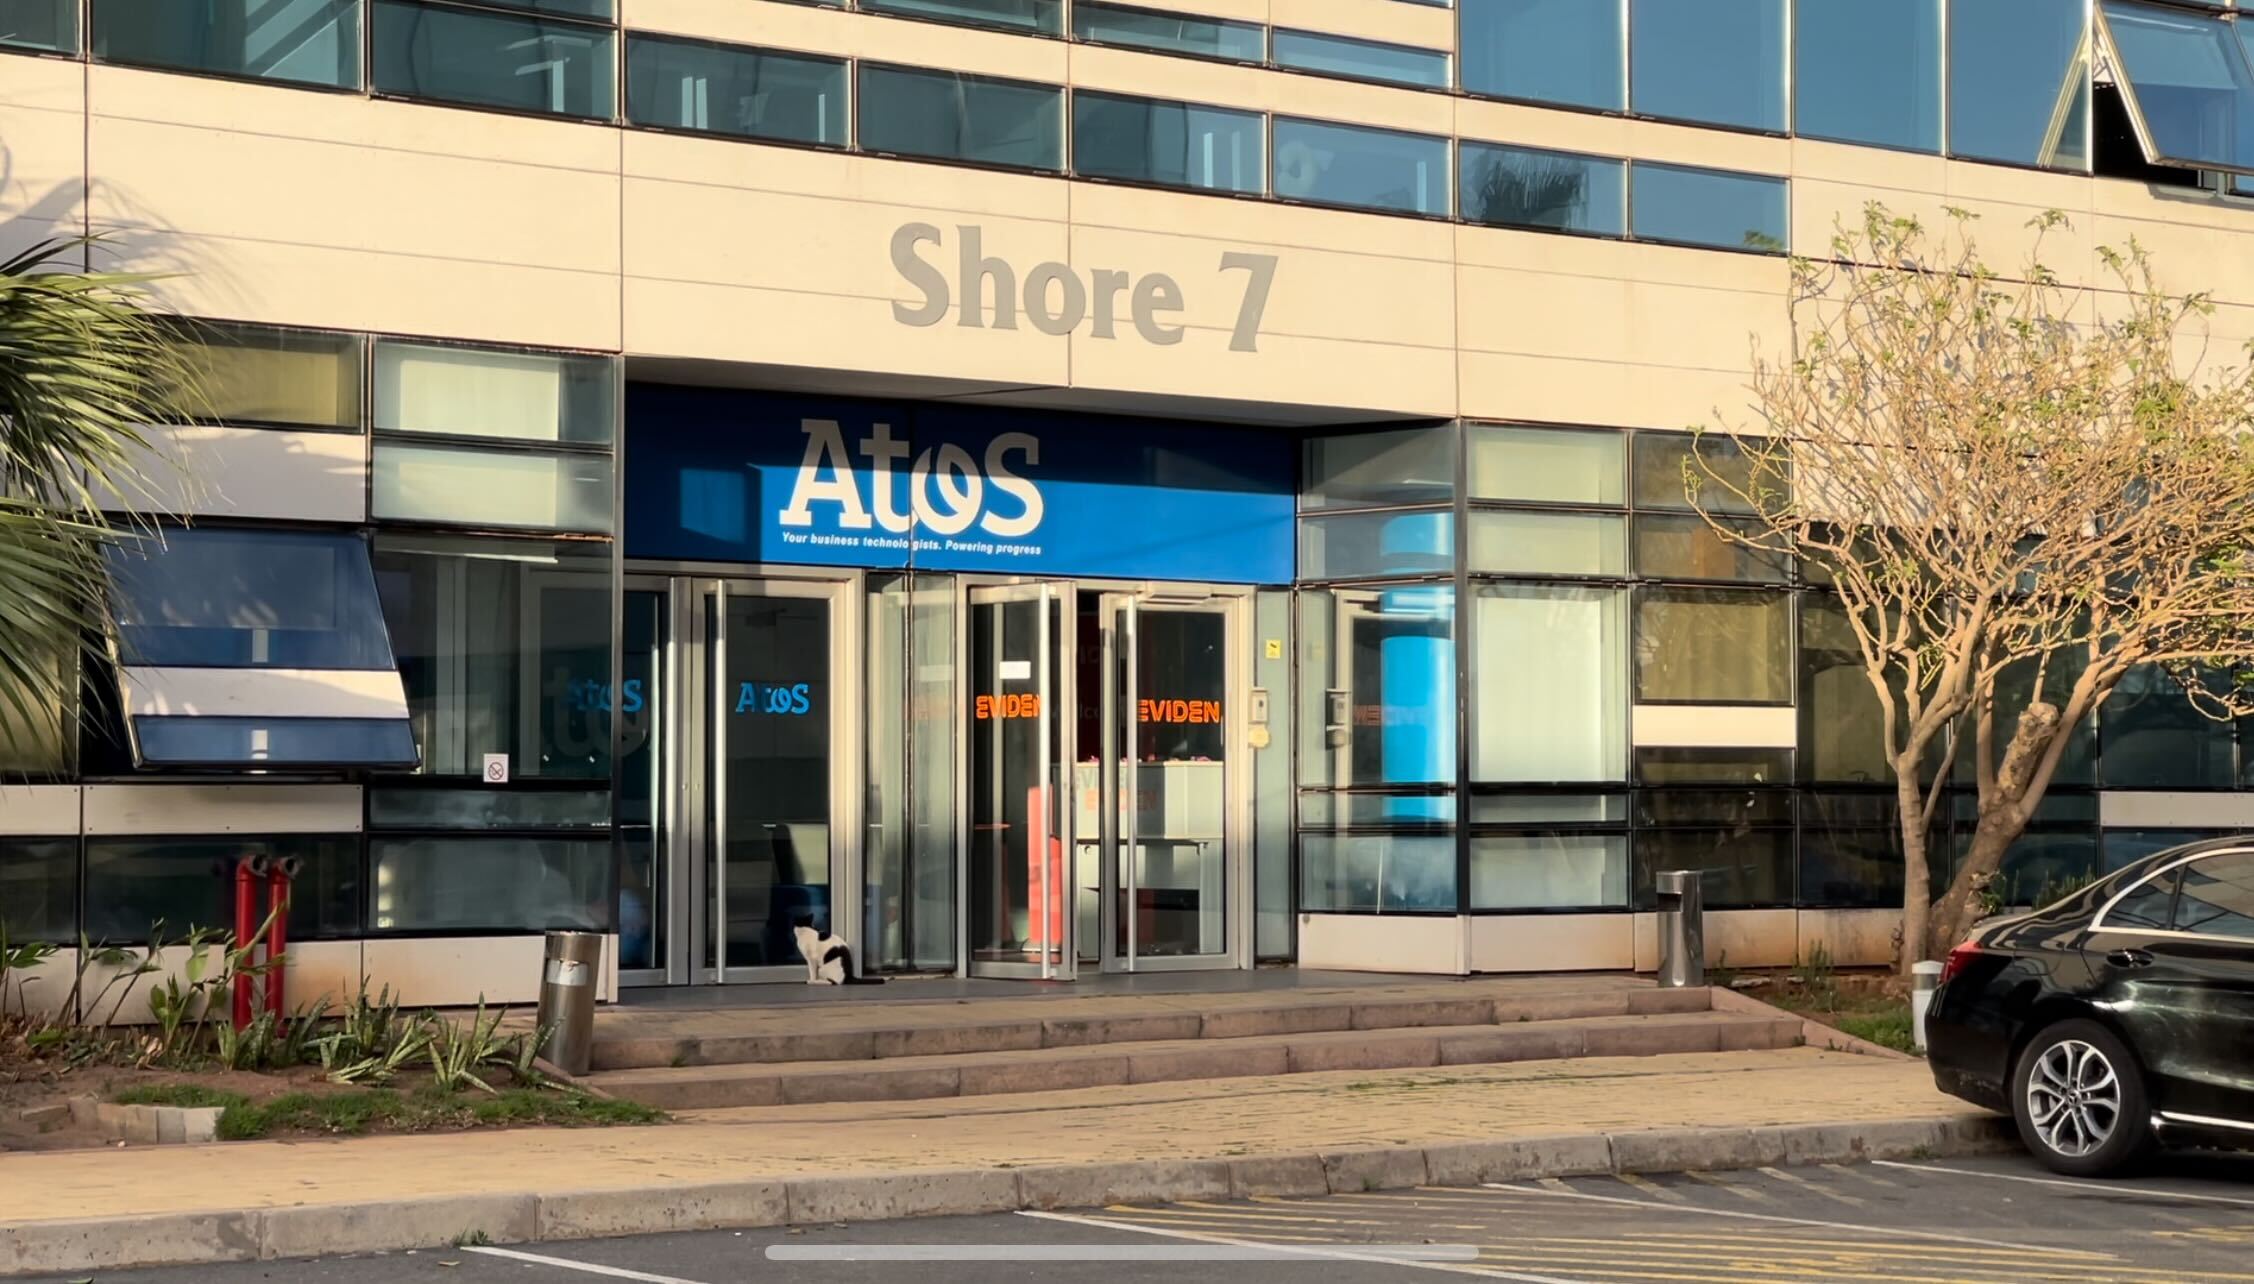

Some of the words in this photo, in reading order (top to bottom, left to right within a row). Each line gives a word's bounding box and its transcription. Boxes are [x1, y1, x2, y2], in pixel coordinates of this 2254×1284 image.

[889, 221, 1185, 346] Shore
[1218, 250, 1279, 353] 7
[782, 532, 808, 544] Your
[810, 534, 859, 547] business
[945, 540, 993, 555] Powering
[996, 543, 1042, 556] progress
[1137, 699, 1220, 724] EVIDEN
